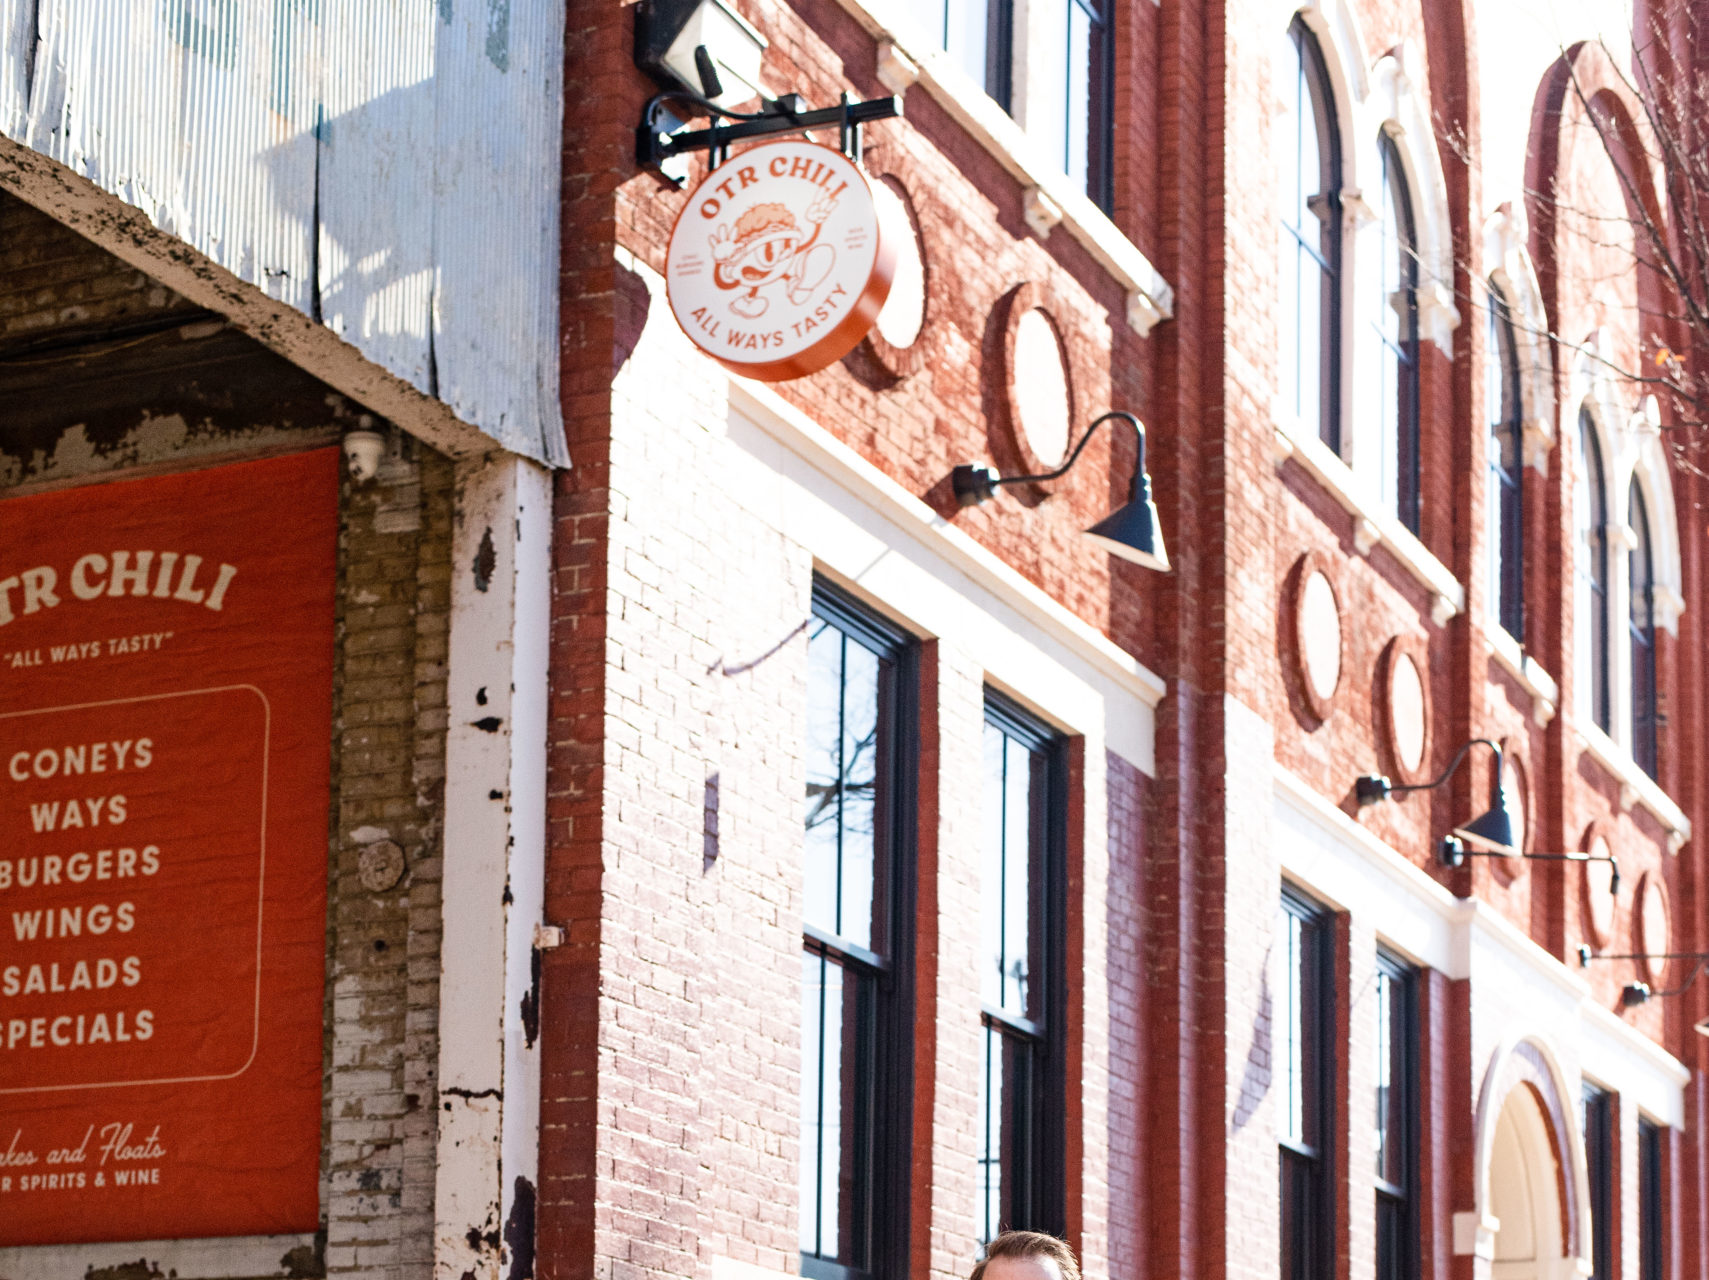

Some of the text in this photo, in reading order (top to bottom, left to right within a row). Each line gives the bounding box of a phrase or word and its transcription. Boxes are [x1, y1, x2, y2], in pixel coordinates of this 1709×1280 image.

[700, 157, 849, 219] OTR CHILI
[690, 283, 848, 350] ALL WAYS TASTY
[70, 550, 237, 611] CHILI
[50, 641, 101, 663] WAYS
[9, 737, 154, 782] CONEYS
[30, 794, 128, 833] WAYS
[0, 844, 161, 889] BURGERS
[12, 901, 136, 941] WINGS
[2, 955, 142, 996] SALADS
[0, 1009, 155, 1049] PECIALS
[46, 1124, 95, 1164] and
[100, 1122, 167, 1166] Floats
[20, 1172, 87, 1192] SPIRITS
[94, 1171, 105, 1187] &
[114, 1168, 160, 1186] WINE
